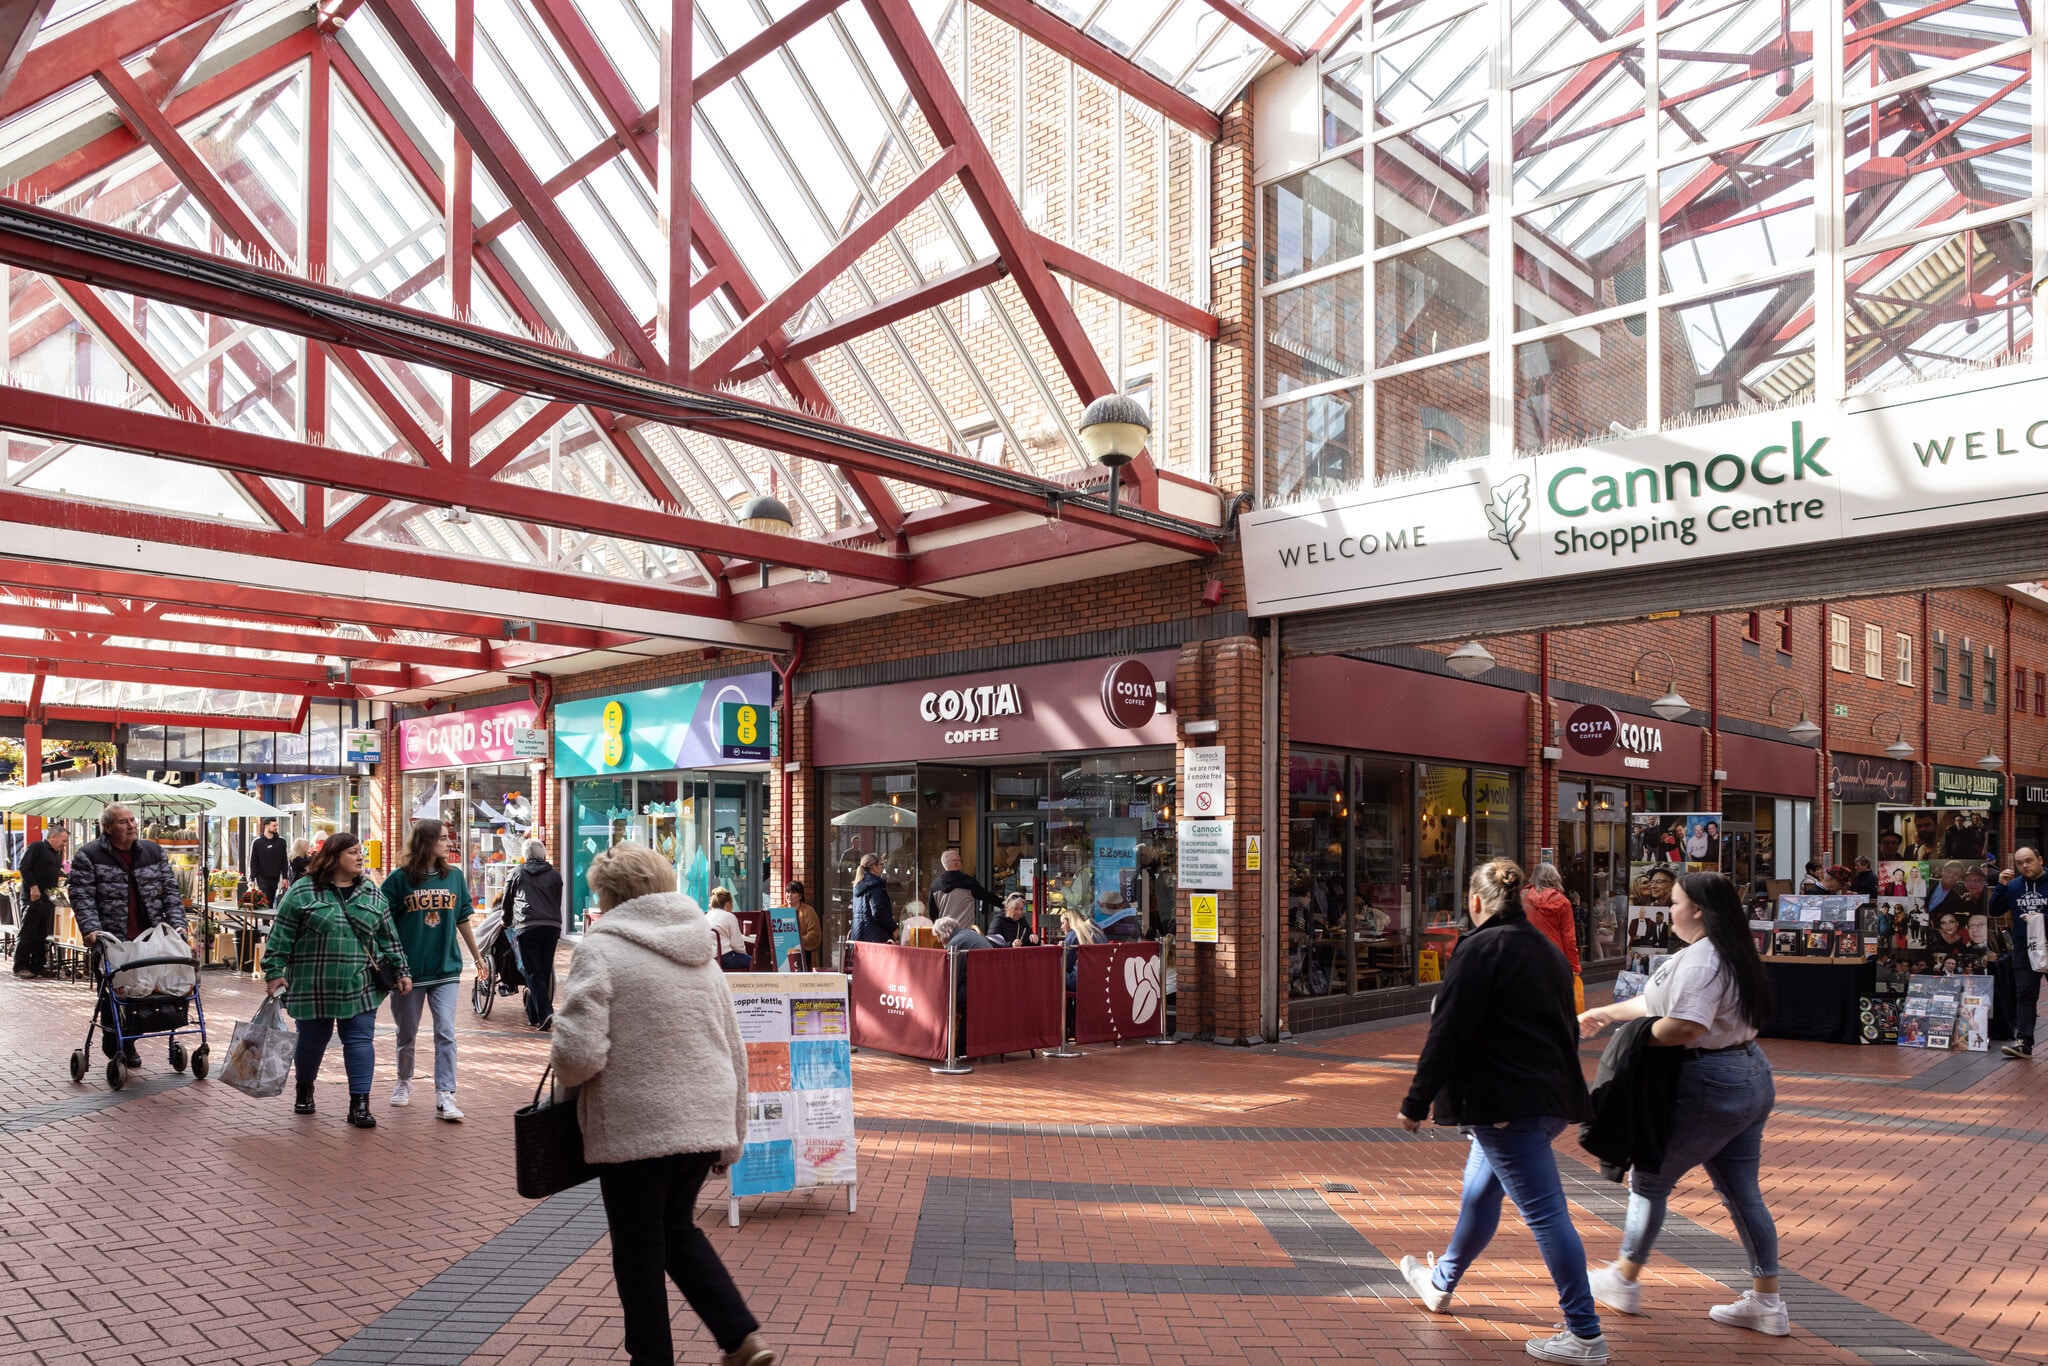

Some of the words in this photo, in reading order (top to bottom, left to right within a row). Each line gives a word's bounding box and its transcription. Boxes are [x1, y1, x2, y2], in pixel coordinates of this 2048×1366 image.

[1547, 420, 1833, 517] Cannock
[1554, 515, 1697, 556] Shopping
[1707, 498, 1824, 532] Centre
[1279, 526, 1427, 568] WELCOME
[1117, 681, 1153, 698] COSTA
[920, 683, 1022, 723] COSTA
[1124, 698, 1145, 706] COFFEE
[1570, 720, 1612, 733] COSTA
[426, 722, 476, 755] CARD
[944, 727, 1000, 744] COFFEE
[1619, 722, 1662, 753] COSTA
[1195, 752, 1218, 760] Cannock
[1938, 772, 1967, 791] HOLLAND
[1973, 775, 1998, 796] BARRETT
[2026, 786, 2048, 803] LITTLE
[1192, 825, 1222, 833] Cannock
[1099, 847, 1112, 858] £2
[1113, 850, 1132, 858] DEAL
[413, 888, 450, 896] HAWKINS
[2016, 898, 2048, 907] TAVERN
[783, 922, 798, 933] DEAL
[760, 997, 783, 1006] kettle
[794, 1001, 813, 1010] Spirit
[813, 1001, 841, 1009] whispers
[879, 993, 914, 1010] COSTA
